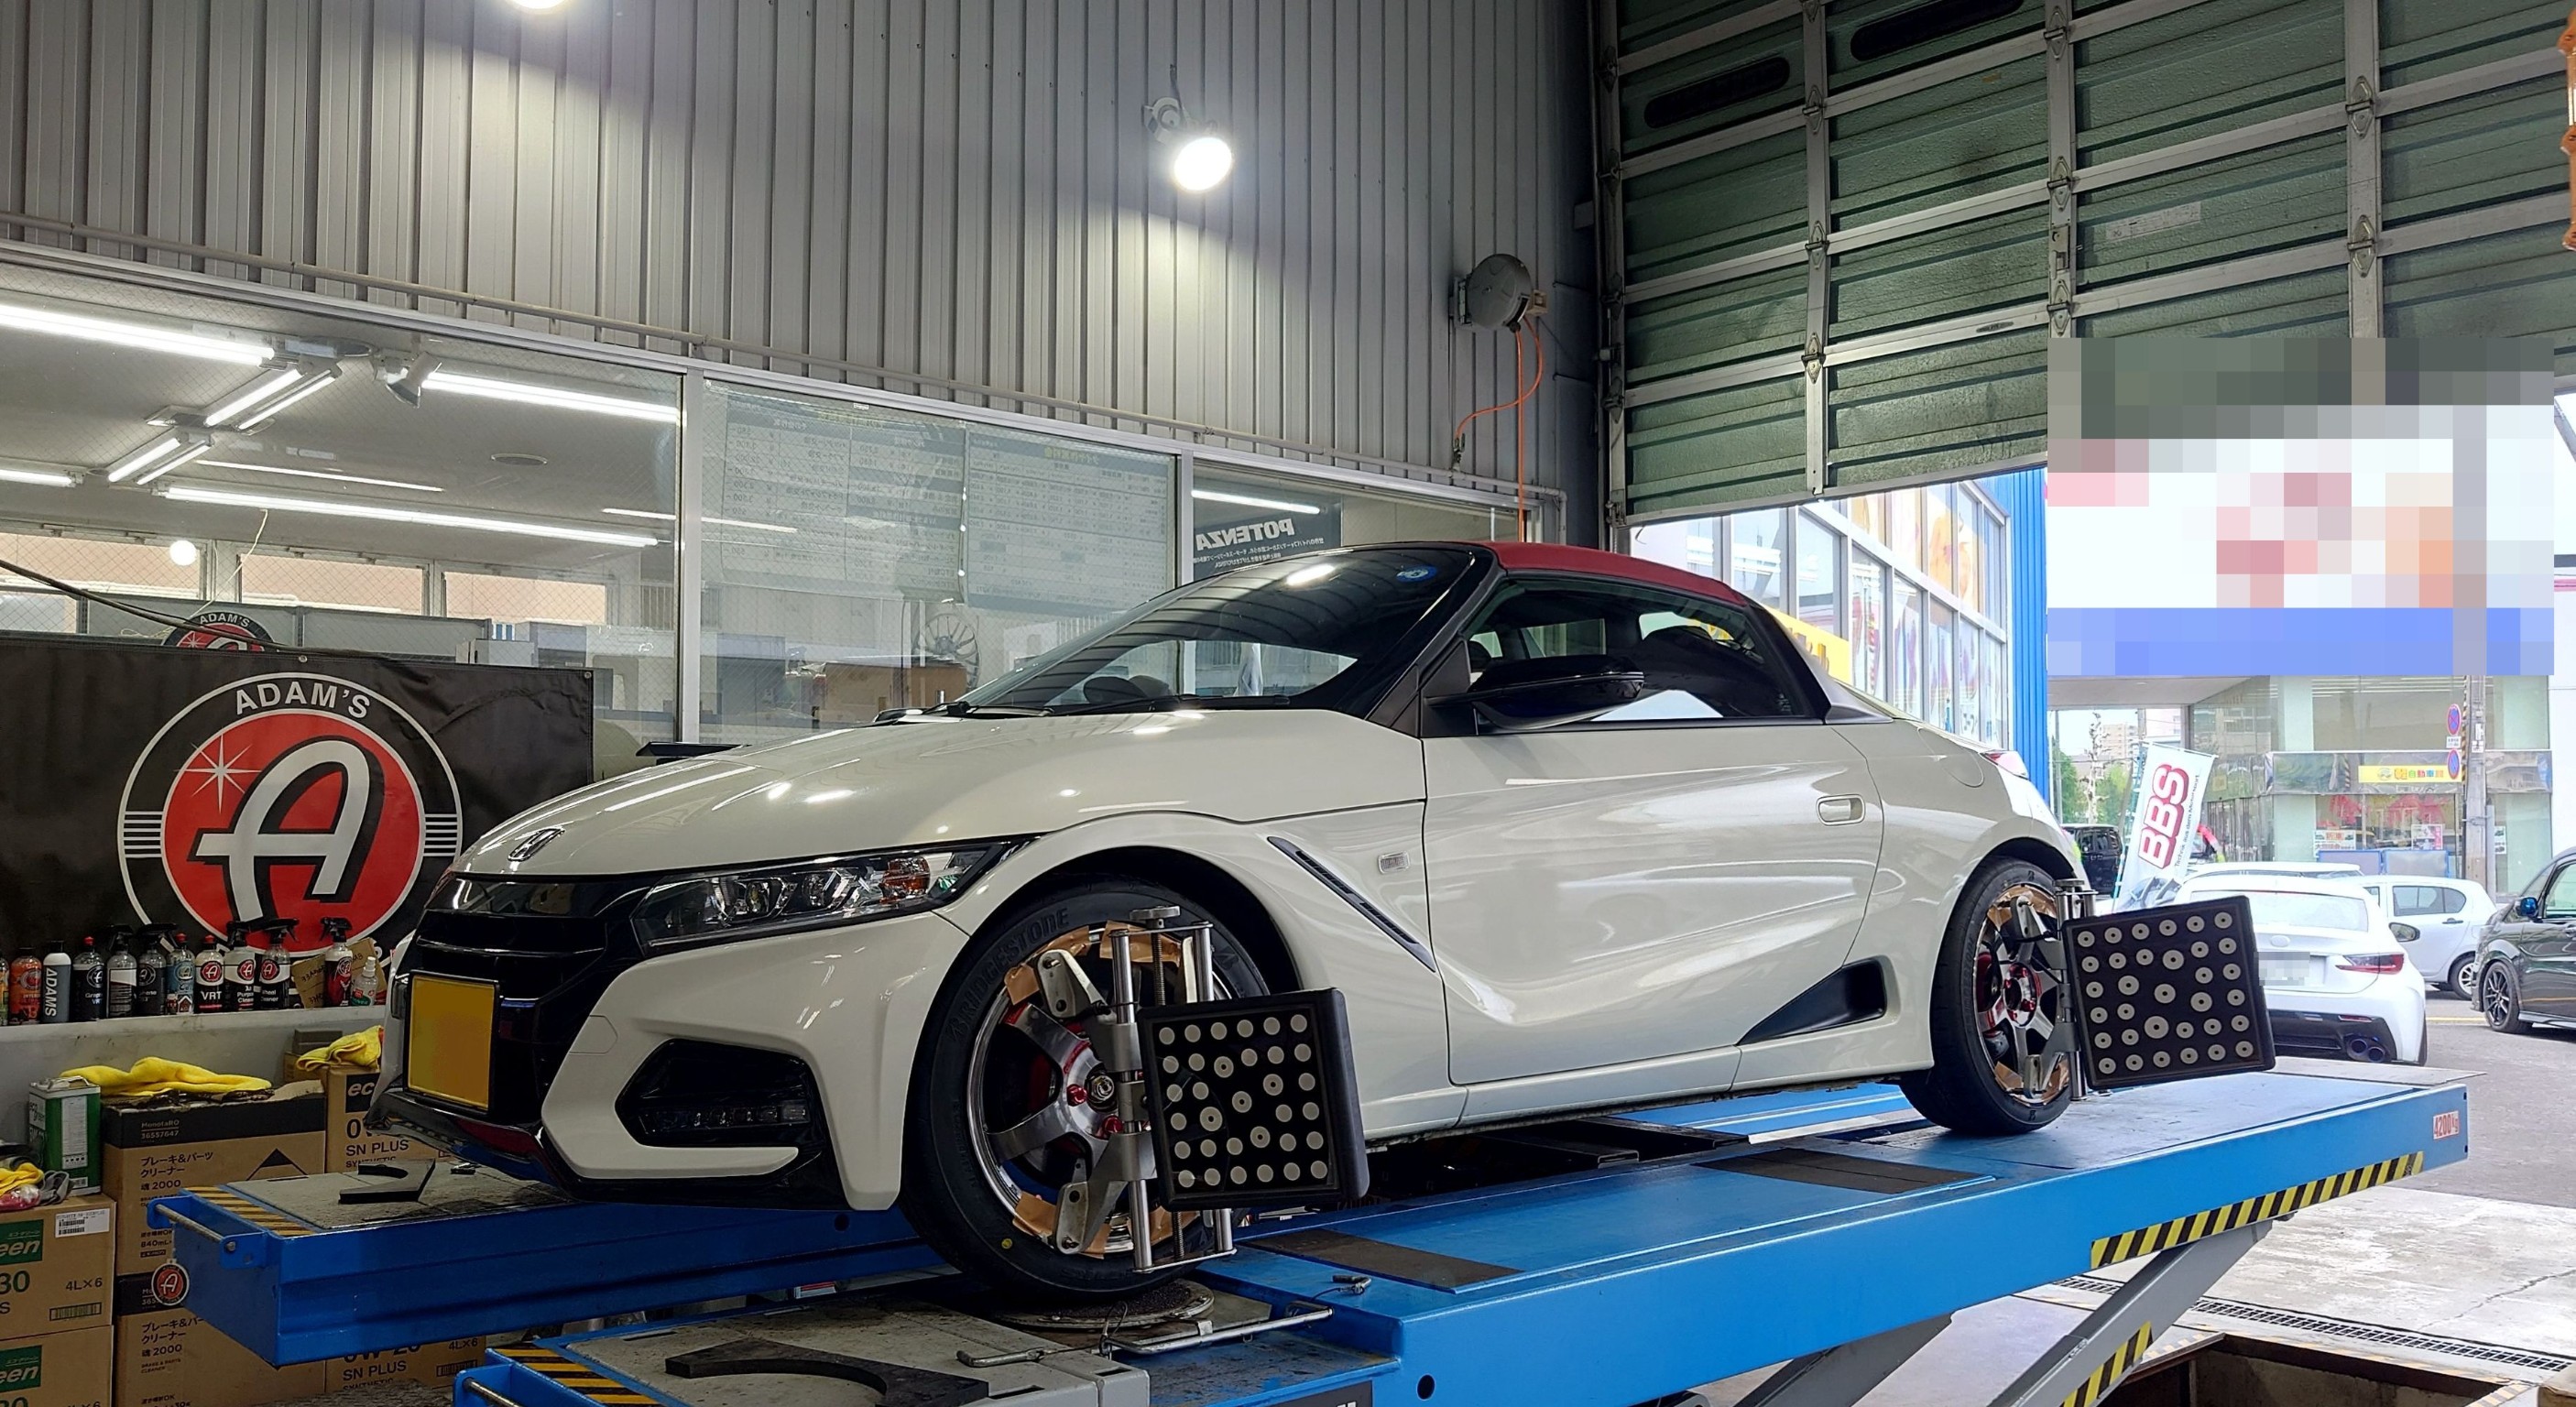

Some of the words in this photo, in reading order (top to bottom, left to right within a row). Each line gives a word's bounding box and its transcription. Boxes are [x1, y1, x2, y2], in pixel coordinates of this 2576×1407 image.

[199, 613, 250, 628] ADAM'S
[235, 681, 371, 719] ADAM'S
[2138, 764, 2189, 869] BBS
[945, 908, 1070, 1041] BRIDGESTONE
[46, 967, 58, 1017] ADAMS
[201, 991, 222, 1000] VRT
[141, 1119, 180, 1129] MonotaRO
[141, 1130, 180, 1140] 36557647
[346, 1144, 366, 1156] SN
[372, 1140, 409, 1154] PLUS
[140, 1168, 185, 1179] クリーナー
[152, 1180, 181, 1190] 2000
[141, 1332, 186, 1345] クリーナー
[152, 1345, 182, 1357] 2000
[344, 1368, 364, 1380] SN
[369, 1360, 407, 1378] PLUS
